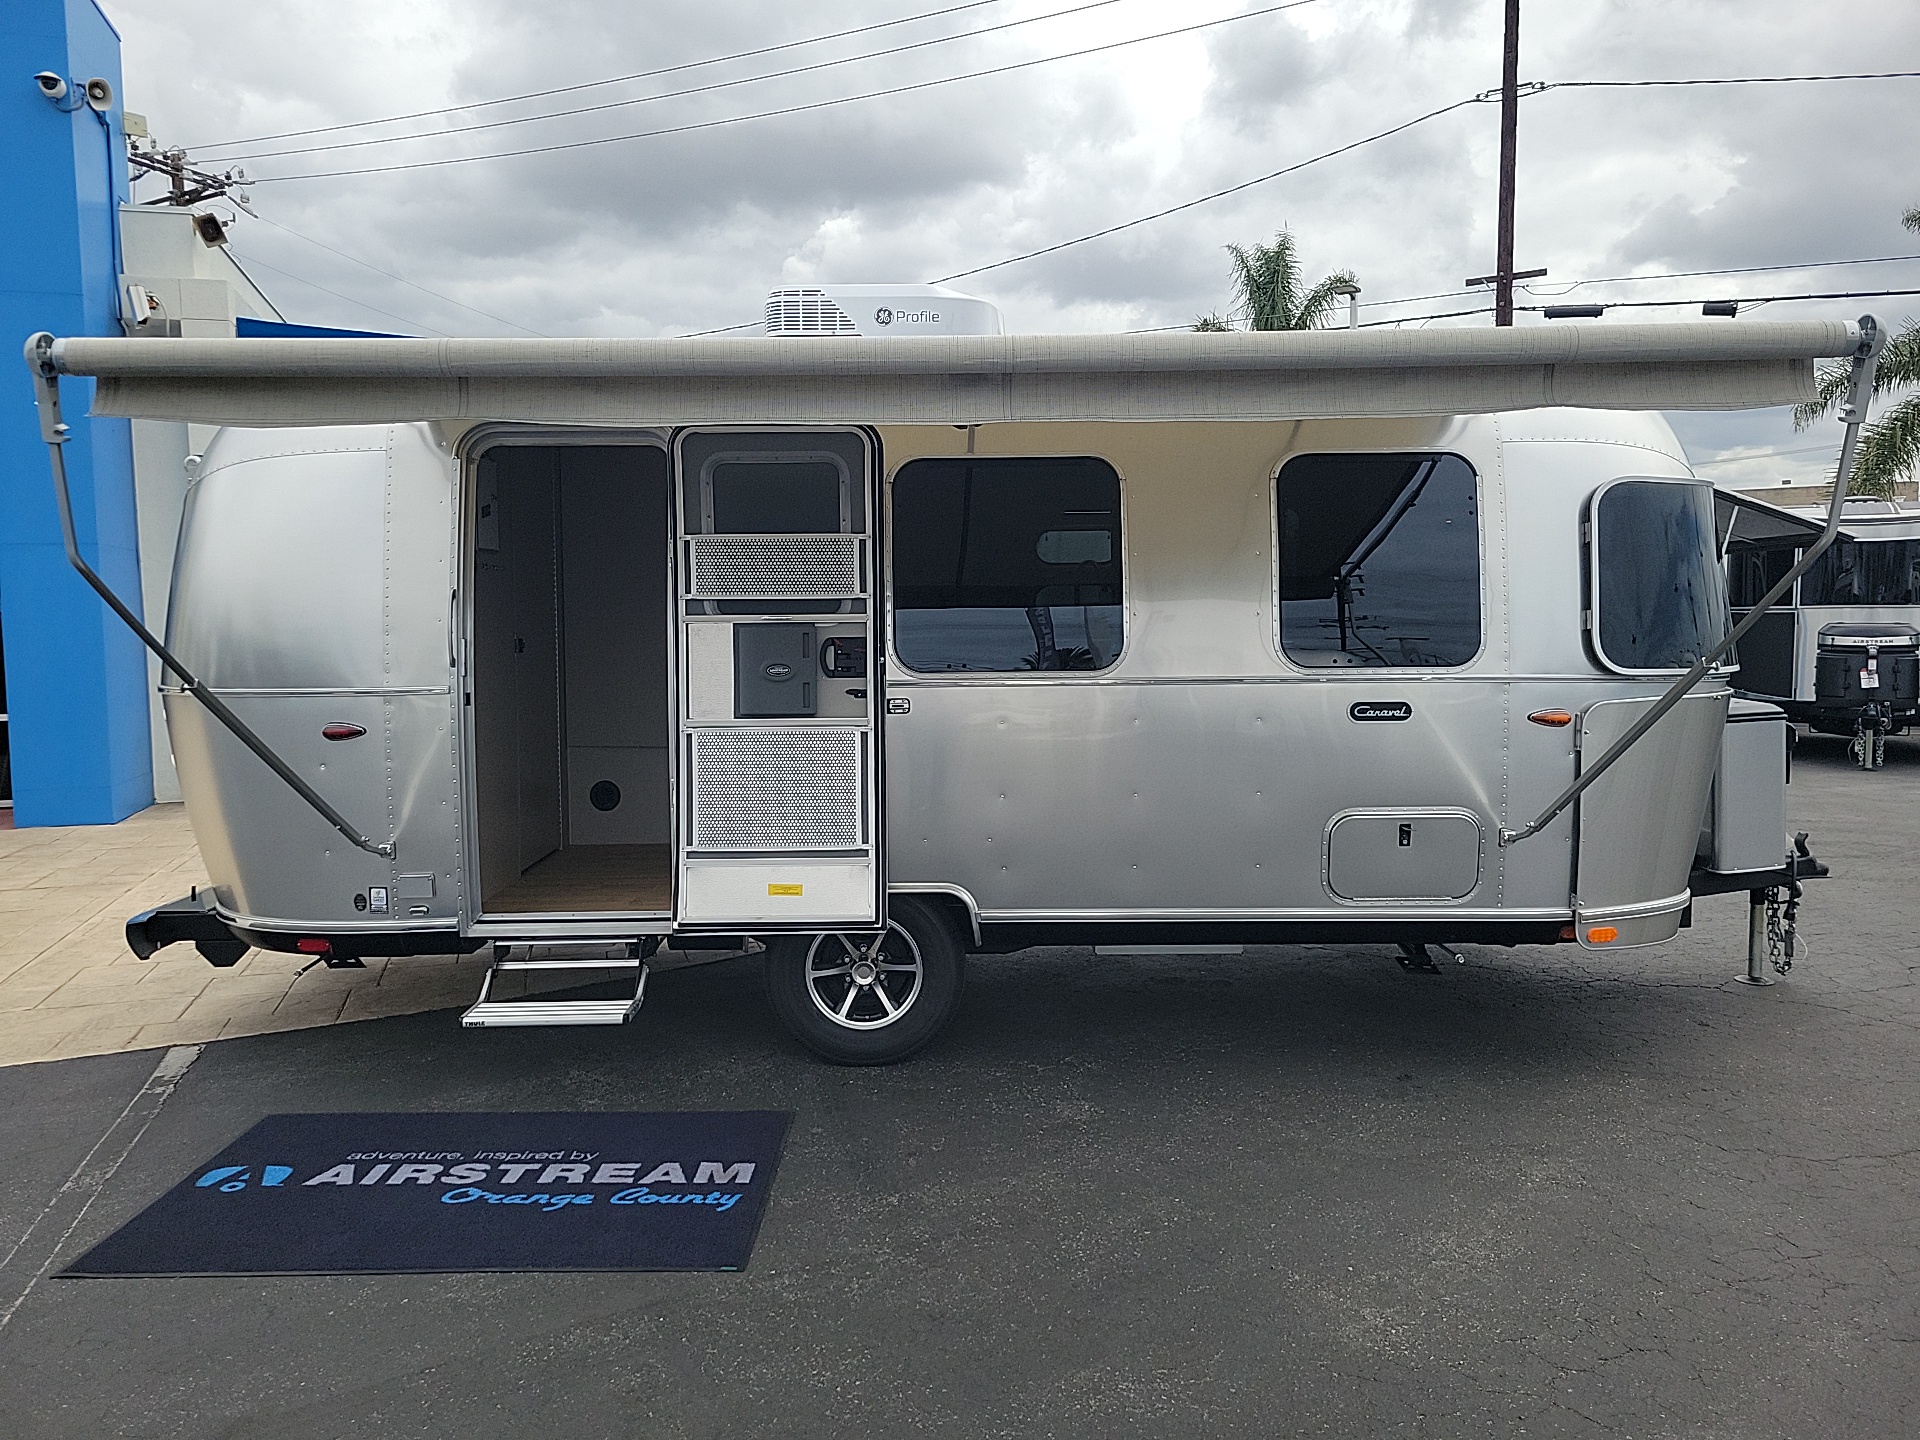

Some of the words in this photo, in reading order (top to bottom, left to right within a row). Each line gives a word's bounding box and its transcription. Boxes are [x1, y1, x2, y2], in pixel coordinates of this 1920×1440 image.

[896, 310, 940, 323] Profile
[1354, 705, 1410, 717] Caravel
[473, 1150, 564, 1161] inspired
[570, 1150, 600, 1161] by
[301, 1161, 756, 1185] AIRSTREAM
[440, 1187, 595, 1212] Orange
[609, 1187, 744, 1212] County
